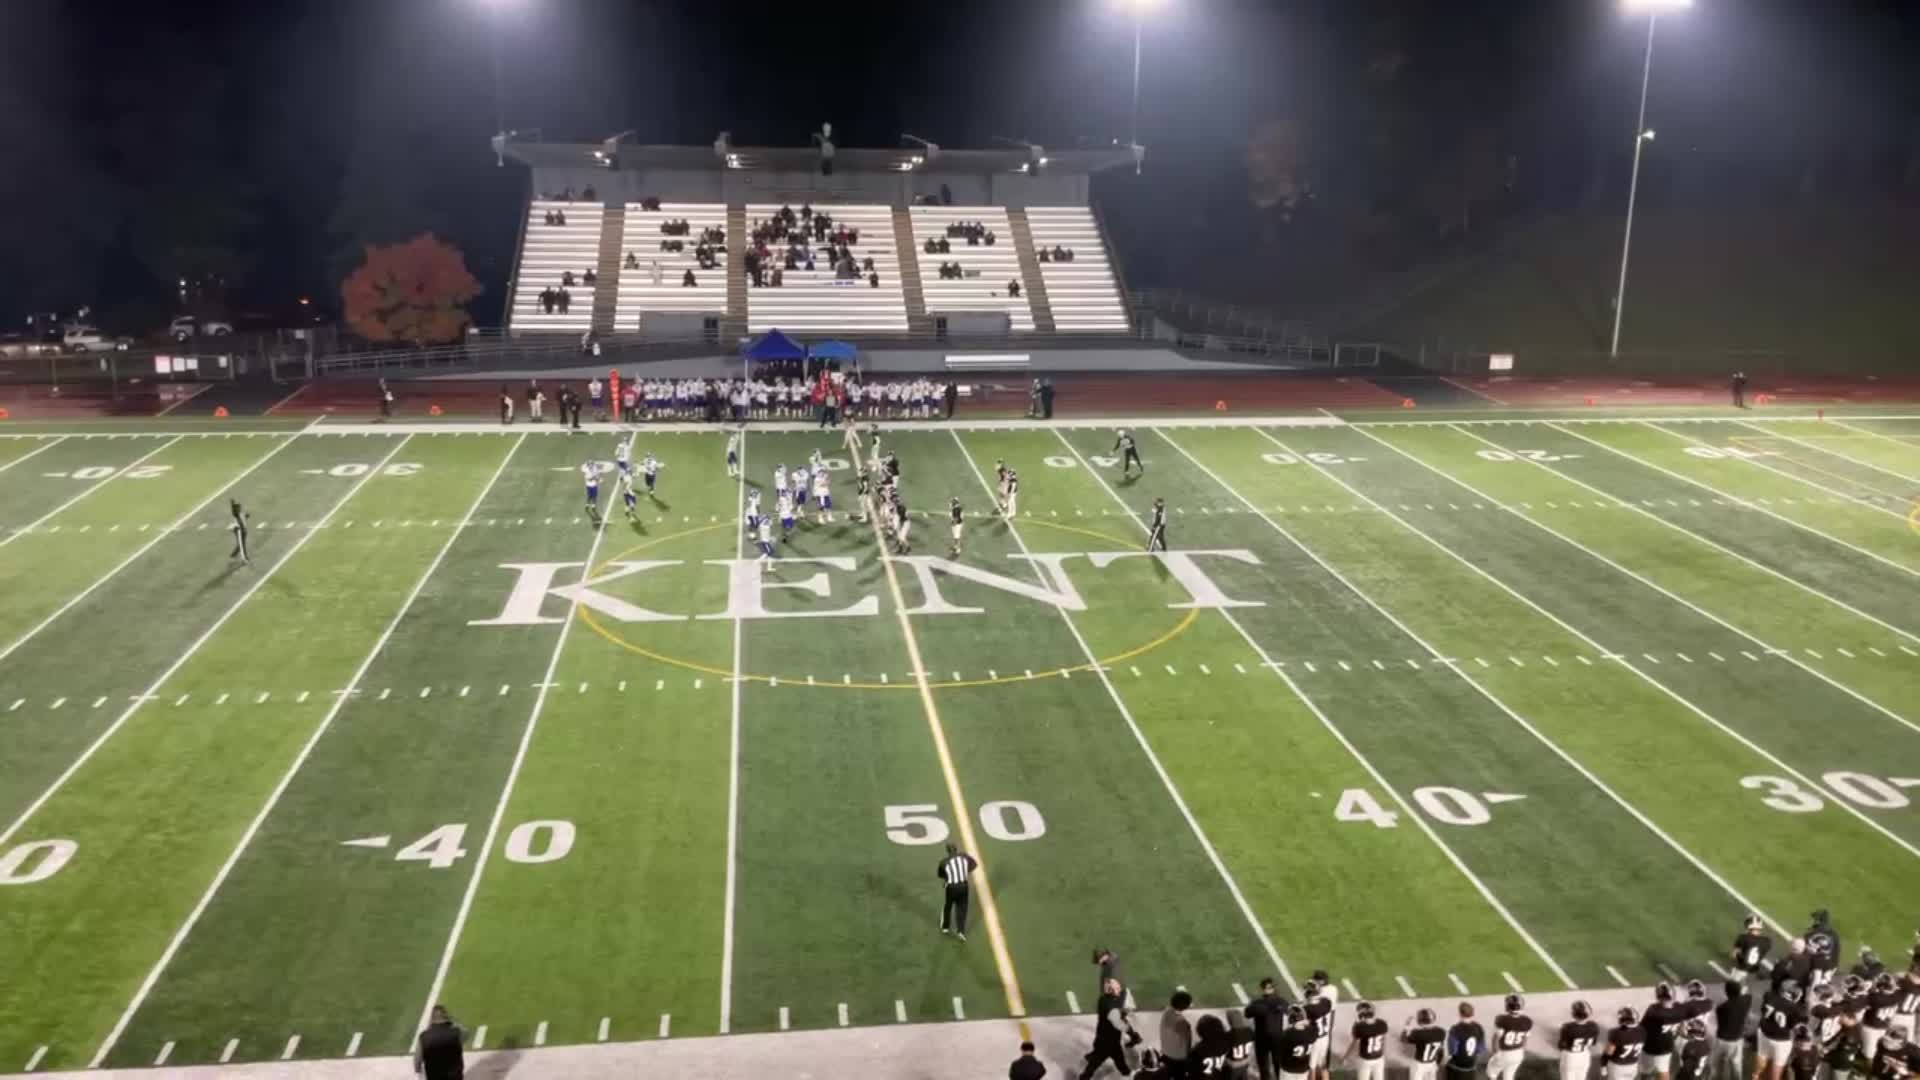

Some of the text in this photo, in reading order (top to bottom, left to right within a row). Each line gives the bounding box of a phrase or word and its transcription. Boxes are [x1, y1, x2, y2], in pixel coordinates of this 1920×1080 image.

[467, 547, 1267, 626] KENT
[1333, 785, 1492, 829] 40
[1739, 770, 1910, 814] 30
[394, 820, 577, 869] 40
[883, 800, 1047, 846] 50
[1367, 1035, 1384, 1055] 15
[1423, 1043, 1442, 1064] 17
